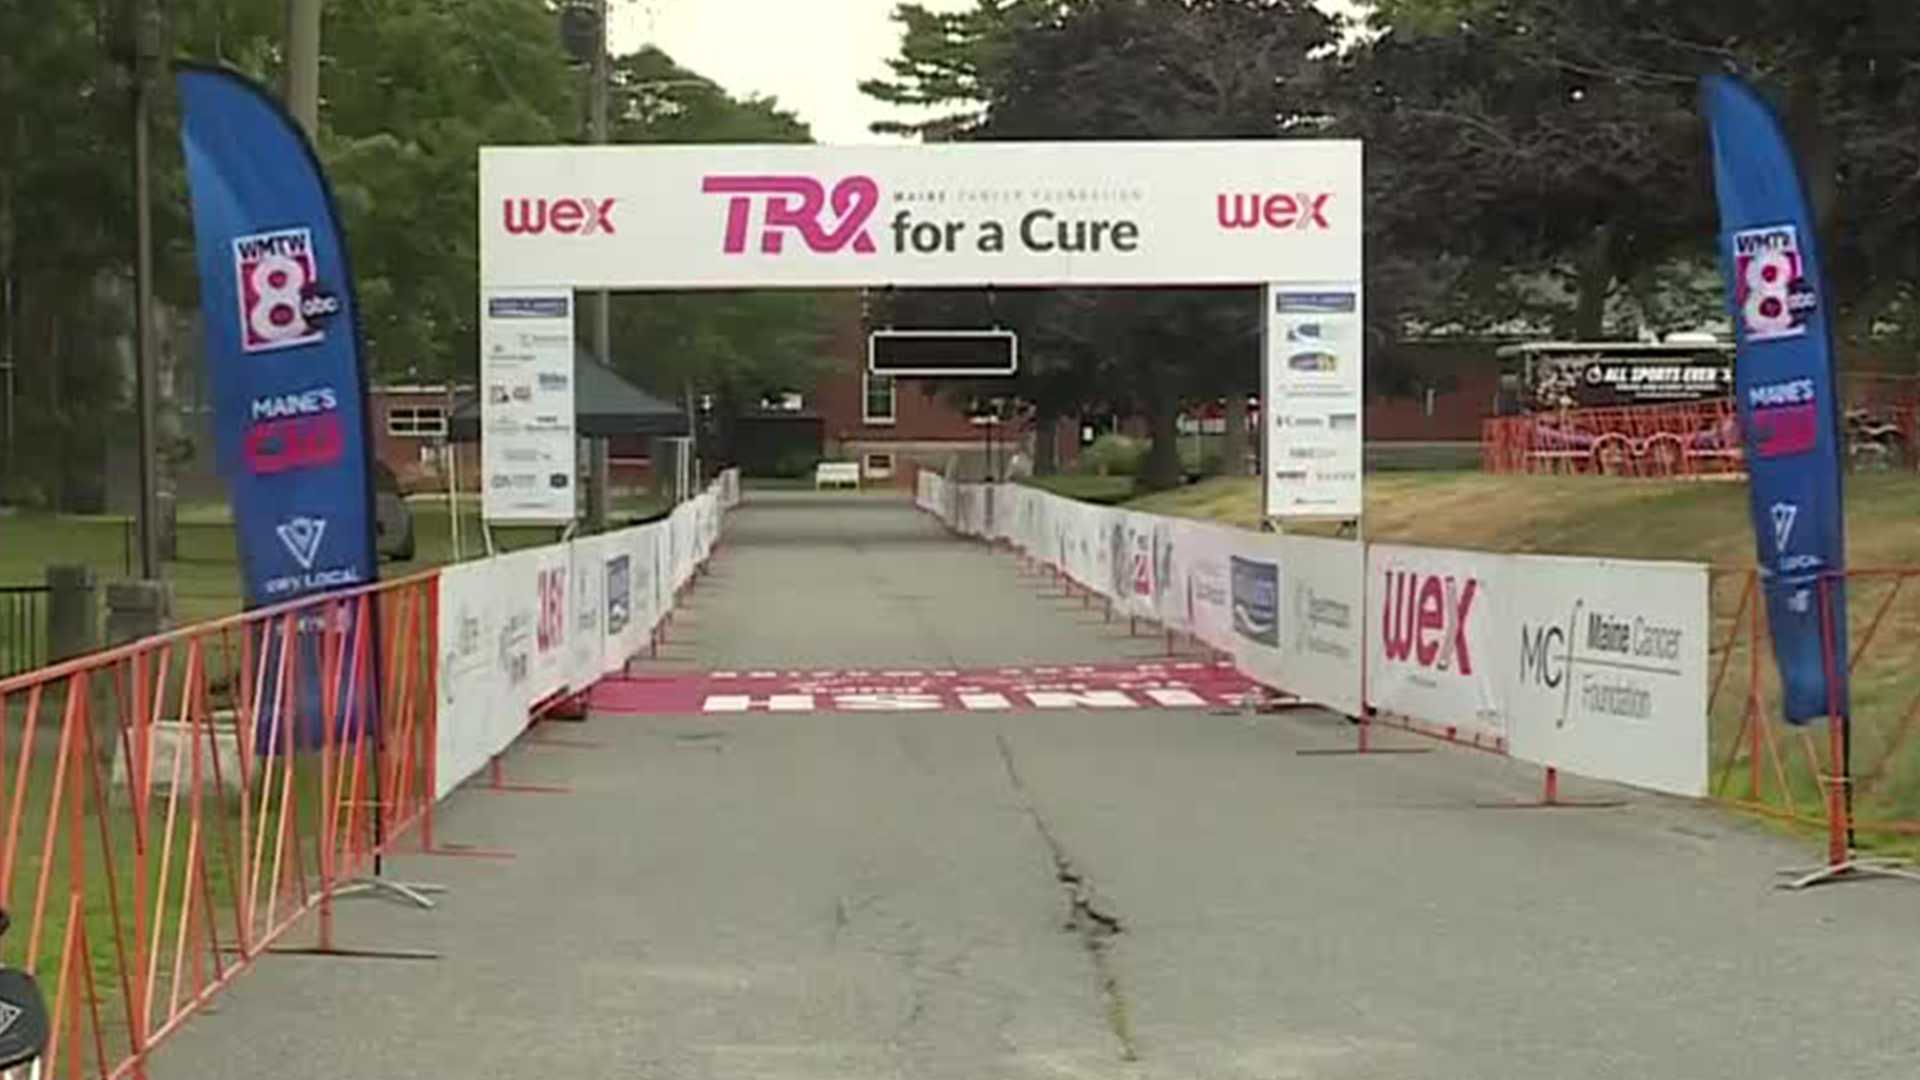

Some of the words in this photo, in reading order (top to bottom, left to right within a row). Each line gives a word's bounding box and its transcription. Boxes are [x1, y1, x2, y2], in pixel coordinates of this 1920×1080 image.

[238, 233, 305, 260] WMTW
[891, 209, 964, 252] for
[976, 220, 1004, 252] a
[1020, 209, 1139, 252] Cure
[250, 258, 307, 341] 8
[302, 296, 338, 316] abc
[1744, 250, 1796, 332] 8
[1604, 366, 1627, 382] ALL
[1631, 366, 1681, 382] SPORTS
[1586, 612, 1630, 653] Maine
[1632, 616, 1683, 660] Cancer
